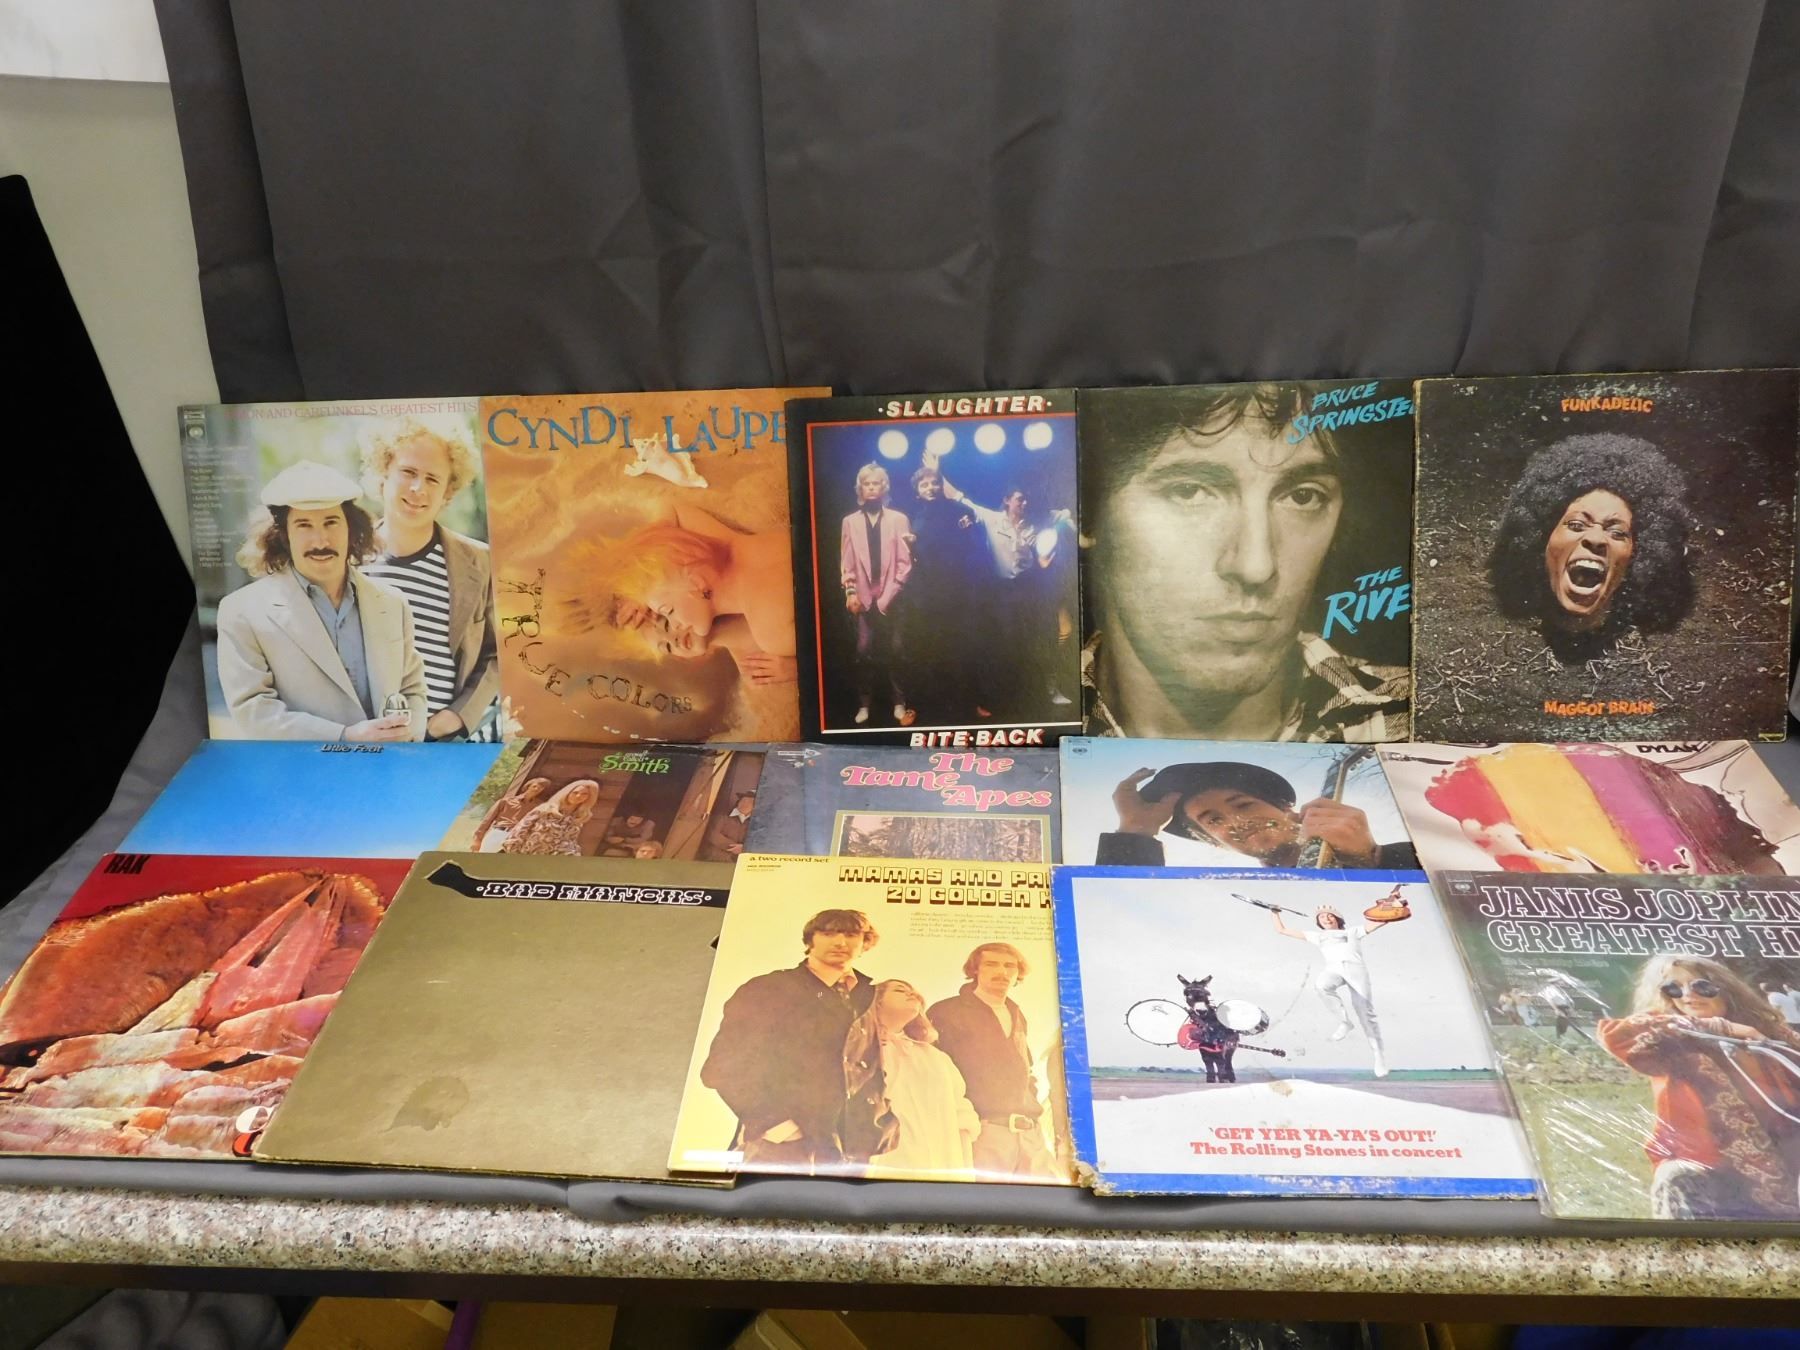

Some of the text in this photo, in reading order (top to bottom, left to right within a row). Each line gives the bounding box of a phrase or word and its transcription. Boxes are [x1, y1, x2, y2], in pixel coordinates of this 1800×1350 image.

[381, 402, 442, 415] GREATEST
[447, 401, 478, 413] HITS
[1311, 381, 1379, 411] BRUCE
[1560, 396, 1654, 413] FUNKADELIC
[487, 405, 634, 451] CYNDI
[1287, 396, 1415, 445] SPRINGSTE
[1353, 566, 1402, 591] THE
[1322, 584, 1411, 640] RIVE
[587, 674, 694, 714] COLORS
[1544, 700, 1656, 716] MAGGOT BRAIN
[1636, 744, 1701, 754] DYLAN
[599, 752, 671, 775] Smith
[929, 752, 1014, 776] The
[840, 765, 961, 791] Tame
[940, 784, 1053, 812] Apes
[838, 864, 1050, 889] MAMAS AND PA
[482, 882, 555, 899] BAD
[929, 887, 1031, 909] GOLDEN
[1479, 885, 1800, 923] JANIS JOPLIN
[1487, 919, 1745, 958] GREATEST
[1258, 1127, 1303, 1141] YER
[1190, 1142, 1463, 1159] The Rolling Stones in concert
